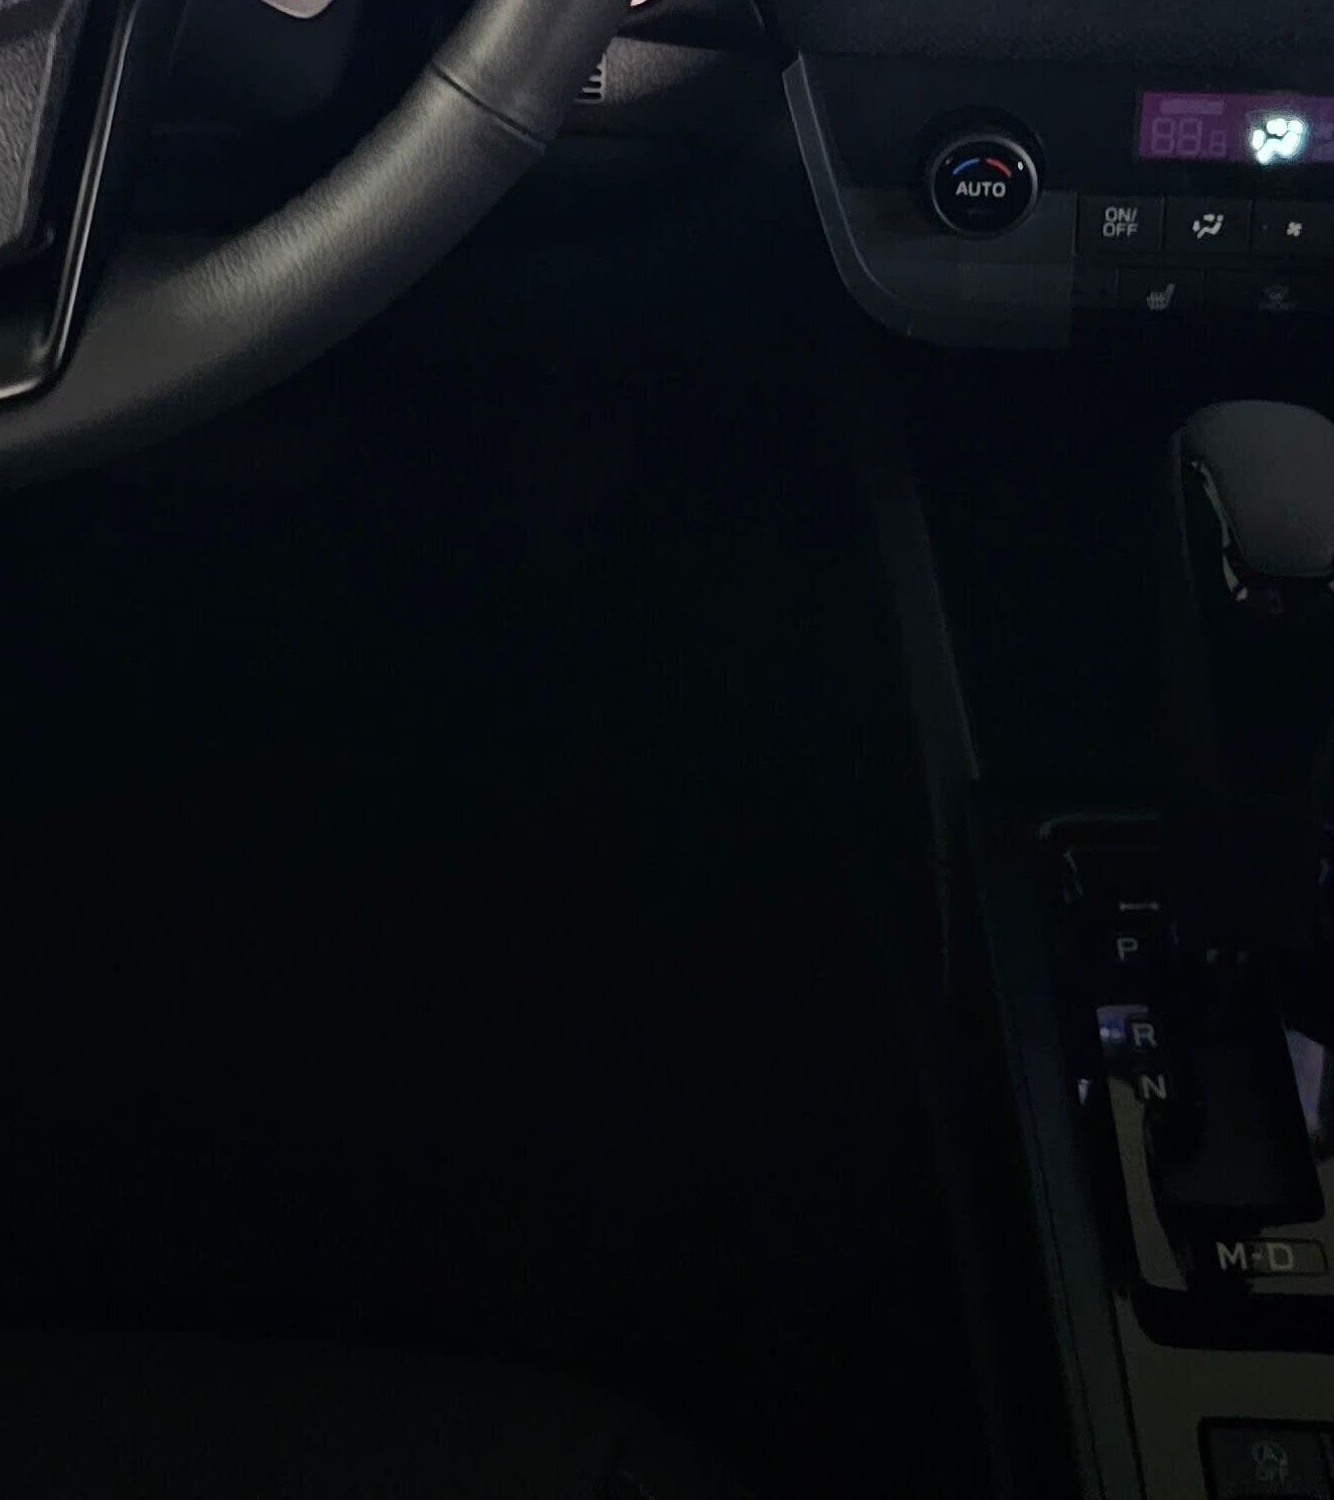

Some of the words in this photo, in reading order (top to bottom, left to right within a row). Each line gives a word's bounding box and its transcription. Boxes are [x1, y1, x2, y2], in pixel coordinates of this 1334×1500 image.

[956, 181, 1006, 197] AUTO
[1105, 206, 1138, 222] ON/
[1102, 222, 1139, 237] OFF
[1117, 937, 1139, 962] P
[1132, 1022, 1157, 1048] R
[1141, 1075, 1166, 1099] N
